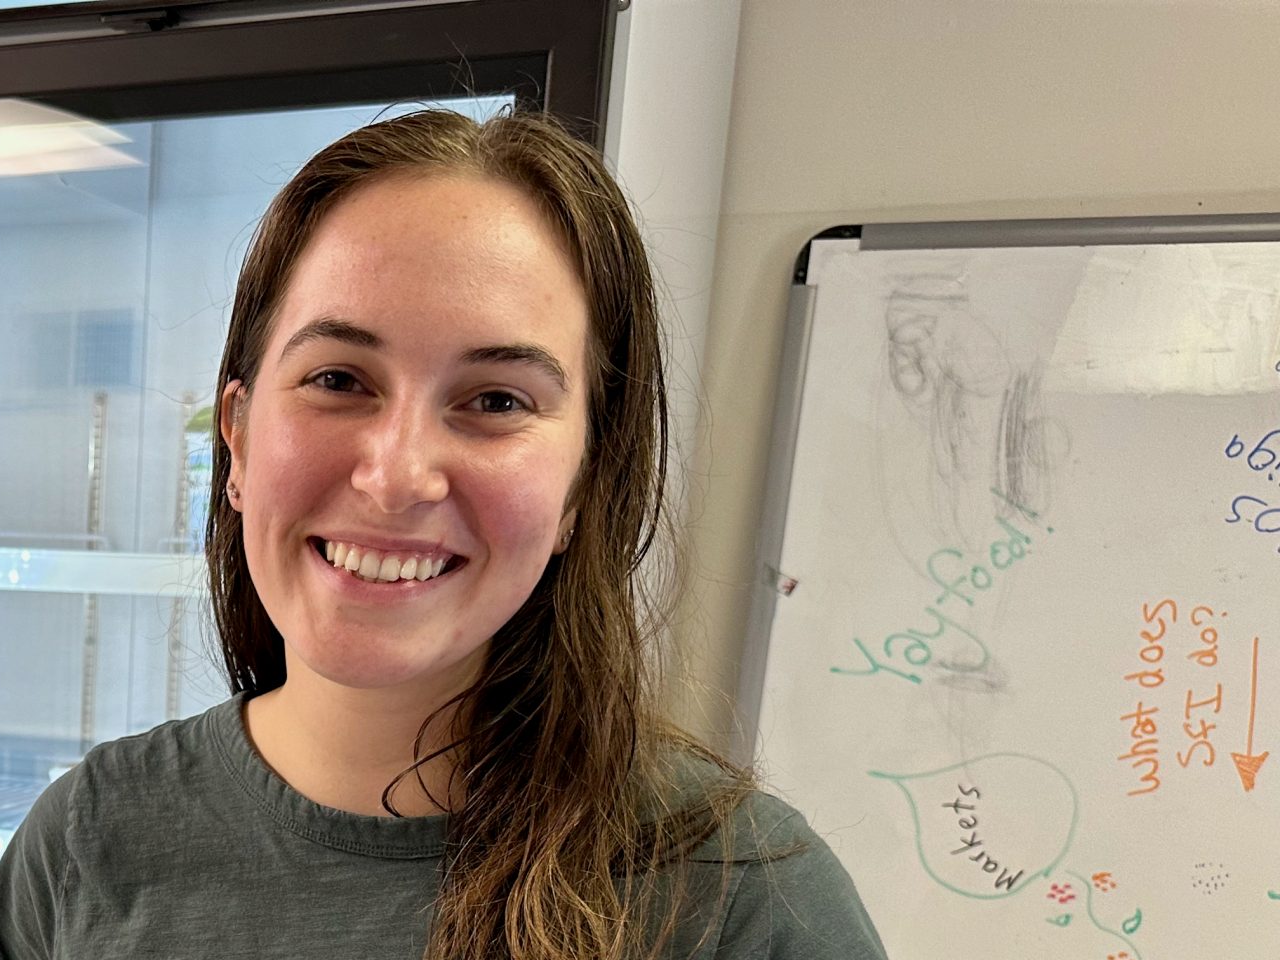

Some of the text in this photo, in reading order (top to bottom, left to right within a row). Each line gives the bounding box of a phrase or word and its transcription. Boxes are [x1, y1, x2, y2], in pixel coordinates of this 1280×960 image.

[830, 607, 990, 684] Yay
[1124, 599, 1177, 688] does
[1187, 606, 1228, 667] do?
[943, 784, 1023, 891] Markets
